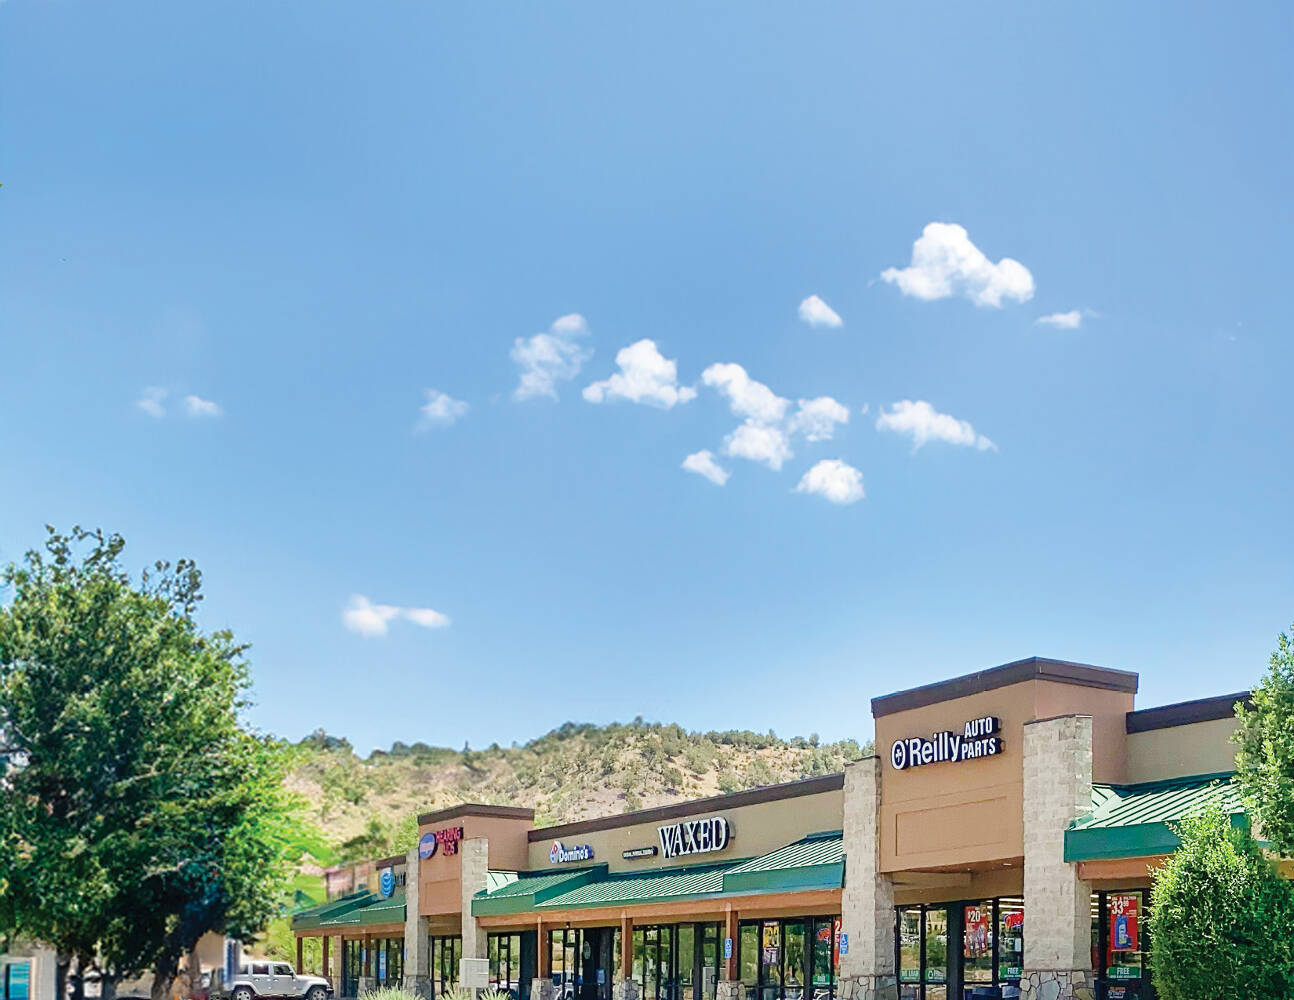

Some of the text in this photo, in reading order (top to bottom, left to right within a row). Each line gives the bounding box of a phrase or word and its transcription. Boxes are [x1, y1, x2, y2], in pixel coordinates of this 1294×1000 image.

[964, 716, 993, 739] AUTO
[891, 731, 961, 770] O'Reilly
[961, 738, 996, 760] PARTS
[657, 816, 727, 859] WAXED
[559, 844, 589, 863] Domino's
[967, 910, 981, 923] $20
[1116, 967, 1130, 975] FREE
